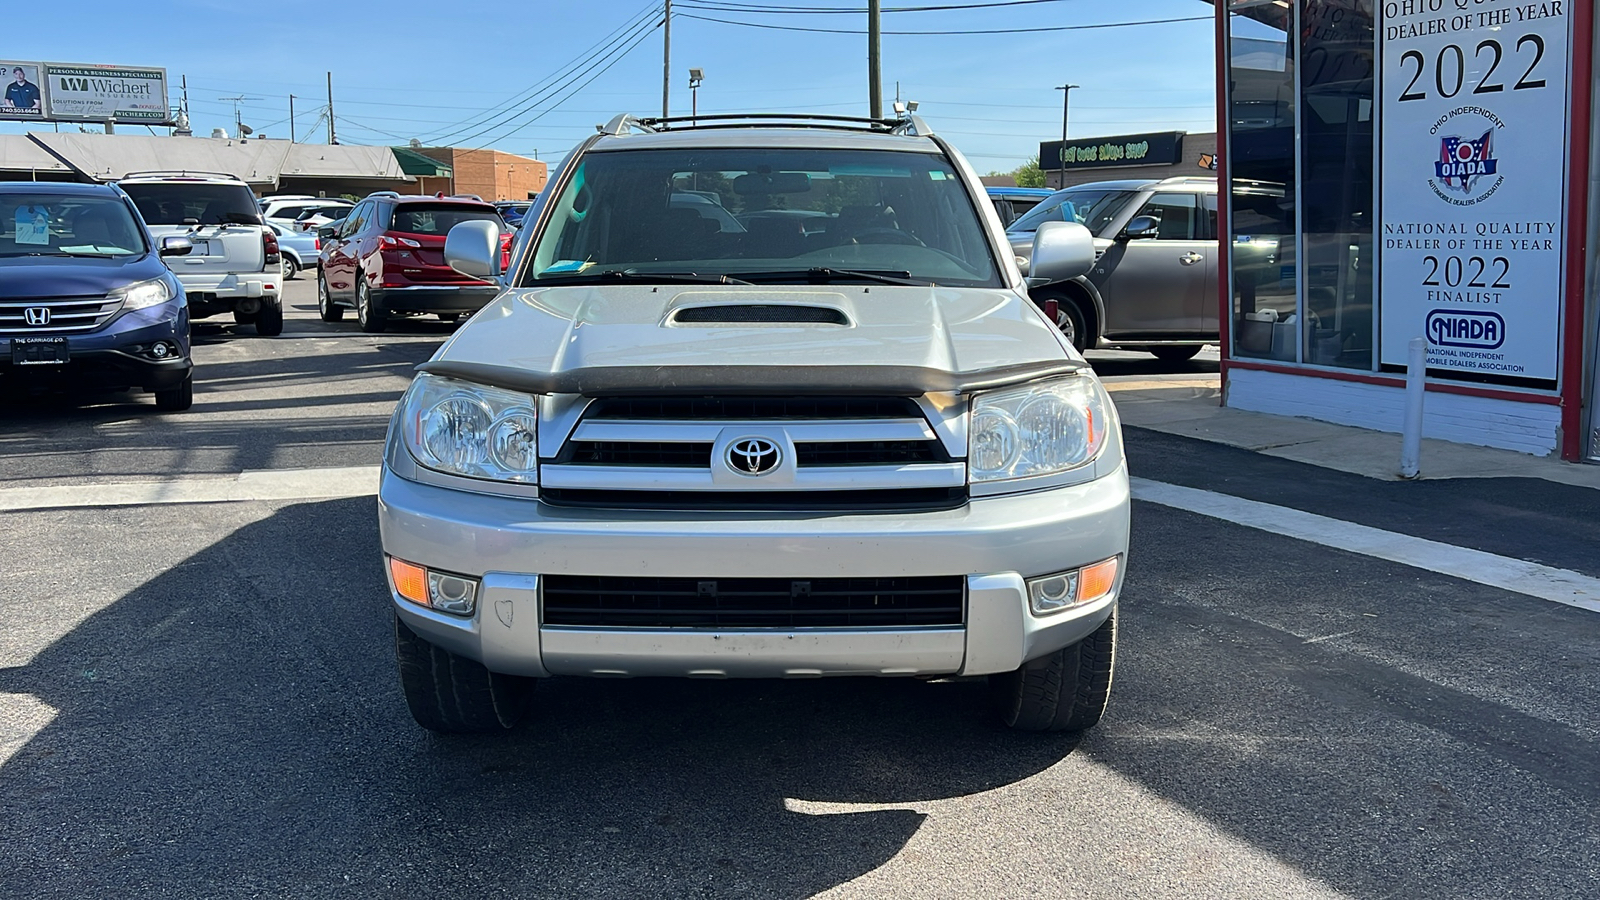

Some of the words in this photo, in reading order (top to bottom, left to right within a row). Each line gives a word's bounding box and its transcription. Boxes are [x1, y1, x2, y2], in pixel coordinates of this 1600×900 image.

[1385, 0, 1442, 19] OHIO
[1387, 18, 1447, 40] DEALER
[1451, 14, 1473, 31] OF
[1477, 8, 1511, 27] THE
[1516, 1, 1562, 21] YEAR
[1398, 34, 1547, 102] 2022
[91, 78, 151, 95] Wichert
[1429, 114, 1448, 135] OHIO
[1448, 106, 1505, 130] INDEPENDENT
[1125, 141, 1148, 159] SHOP
[1441, 161, 1486, 176] OIADA
[1427, 179, 1452, 205] AUTOMOBILE
[1453, 198, 1475, 206] DEALERS
[1476, 175, 1504, 204] ASSOCIATION
[1385, 223, 1468, 235] NATIONAL
[1475, 222, 1556, 236] QUALITY
[1386, 239, 1440, 249] DEALER
[1447, 239, 1466, 249] OF
[1473, 239, 1503, 250] THE
[1511, 240, 1553, 250] YEAR
[1421, 255, 1511, 288] 2022
[1427, 290, 1502, 304] FINALIST
[1431, 317, 1497, 341] NIADA
[1426, 348, 1457, 357] NATIONAL
[1459, 351, 1504, 360] INDEPENDENT
[1425, 357, 1447, 366] MOBILE
[1449, 359, 1477, 368] DEALERS
[1477, 362, 1524, 373] ASSOCIATION
